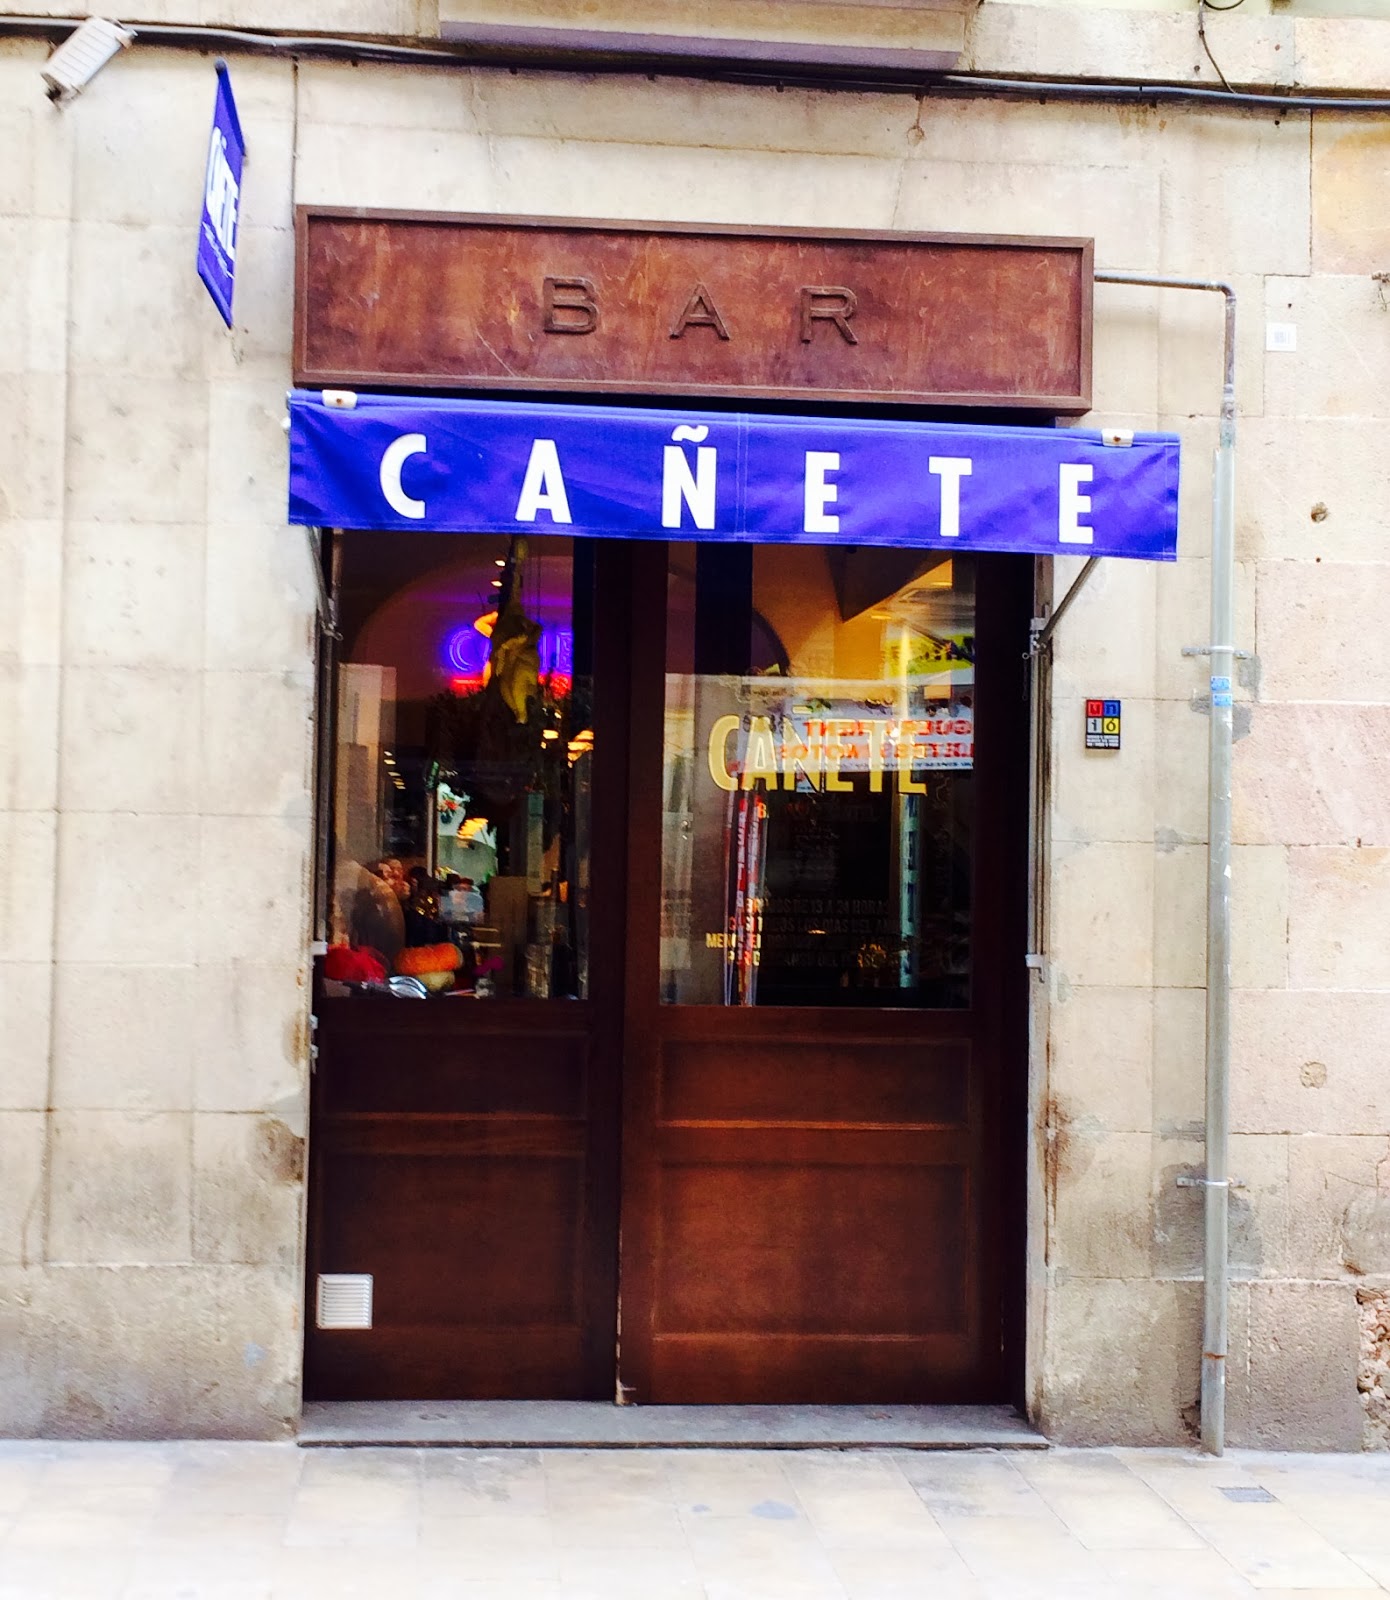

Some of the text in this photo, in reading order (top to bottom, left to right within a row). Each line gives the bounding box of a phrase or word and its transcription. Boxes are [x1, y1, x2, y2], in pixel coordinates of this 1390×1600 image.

[542, 275, 859, 346] BAR
[379, 424, 1095, 546] CAÑETE
[707, 705, 928, 796] CAÑETE
